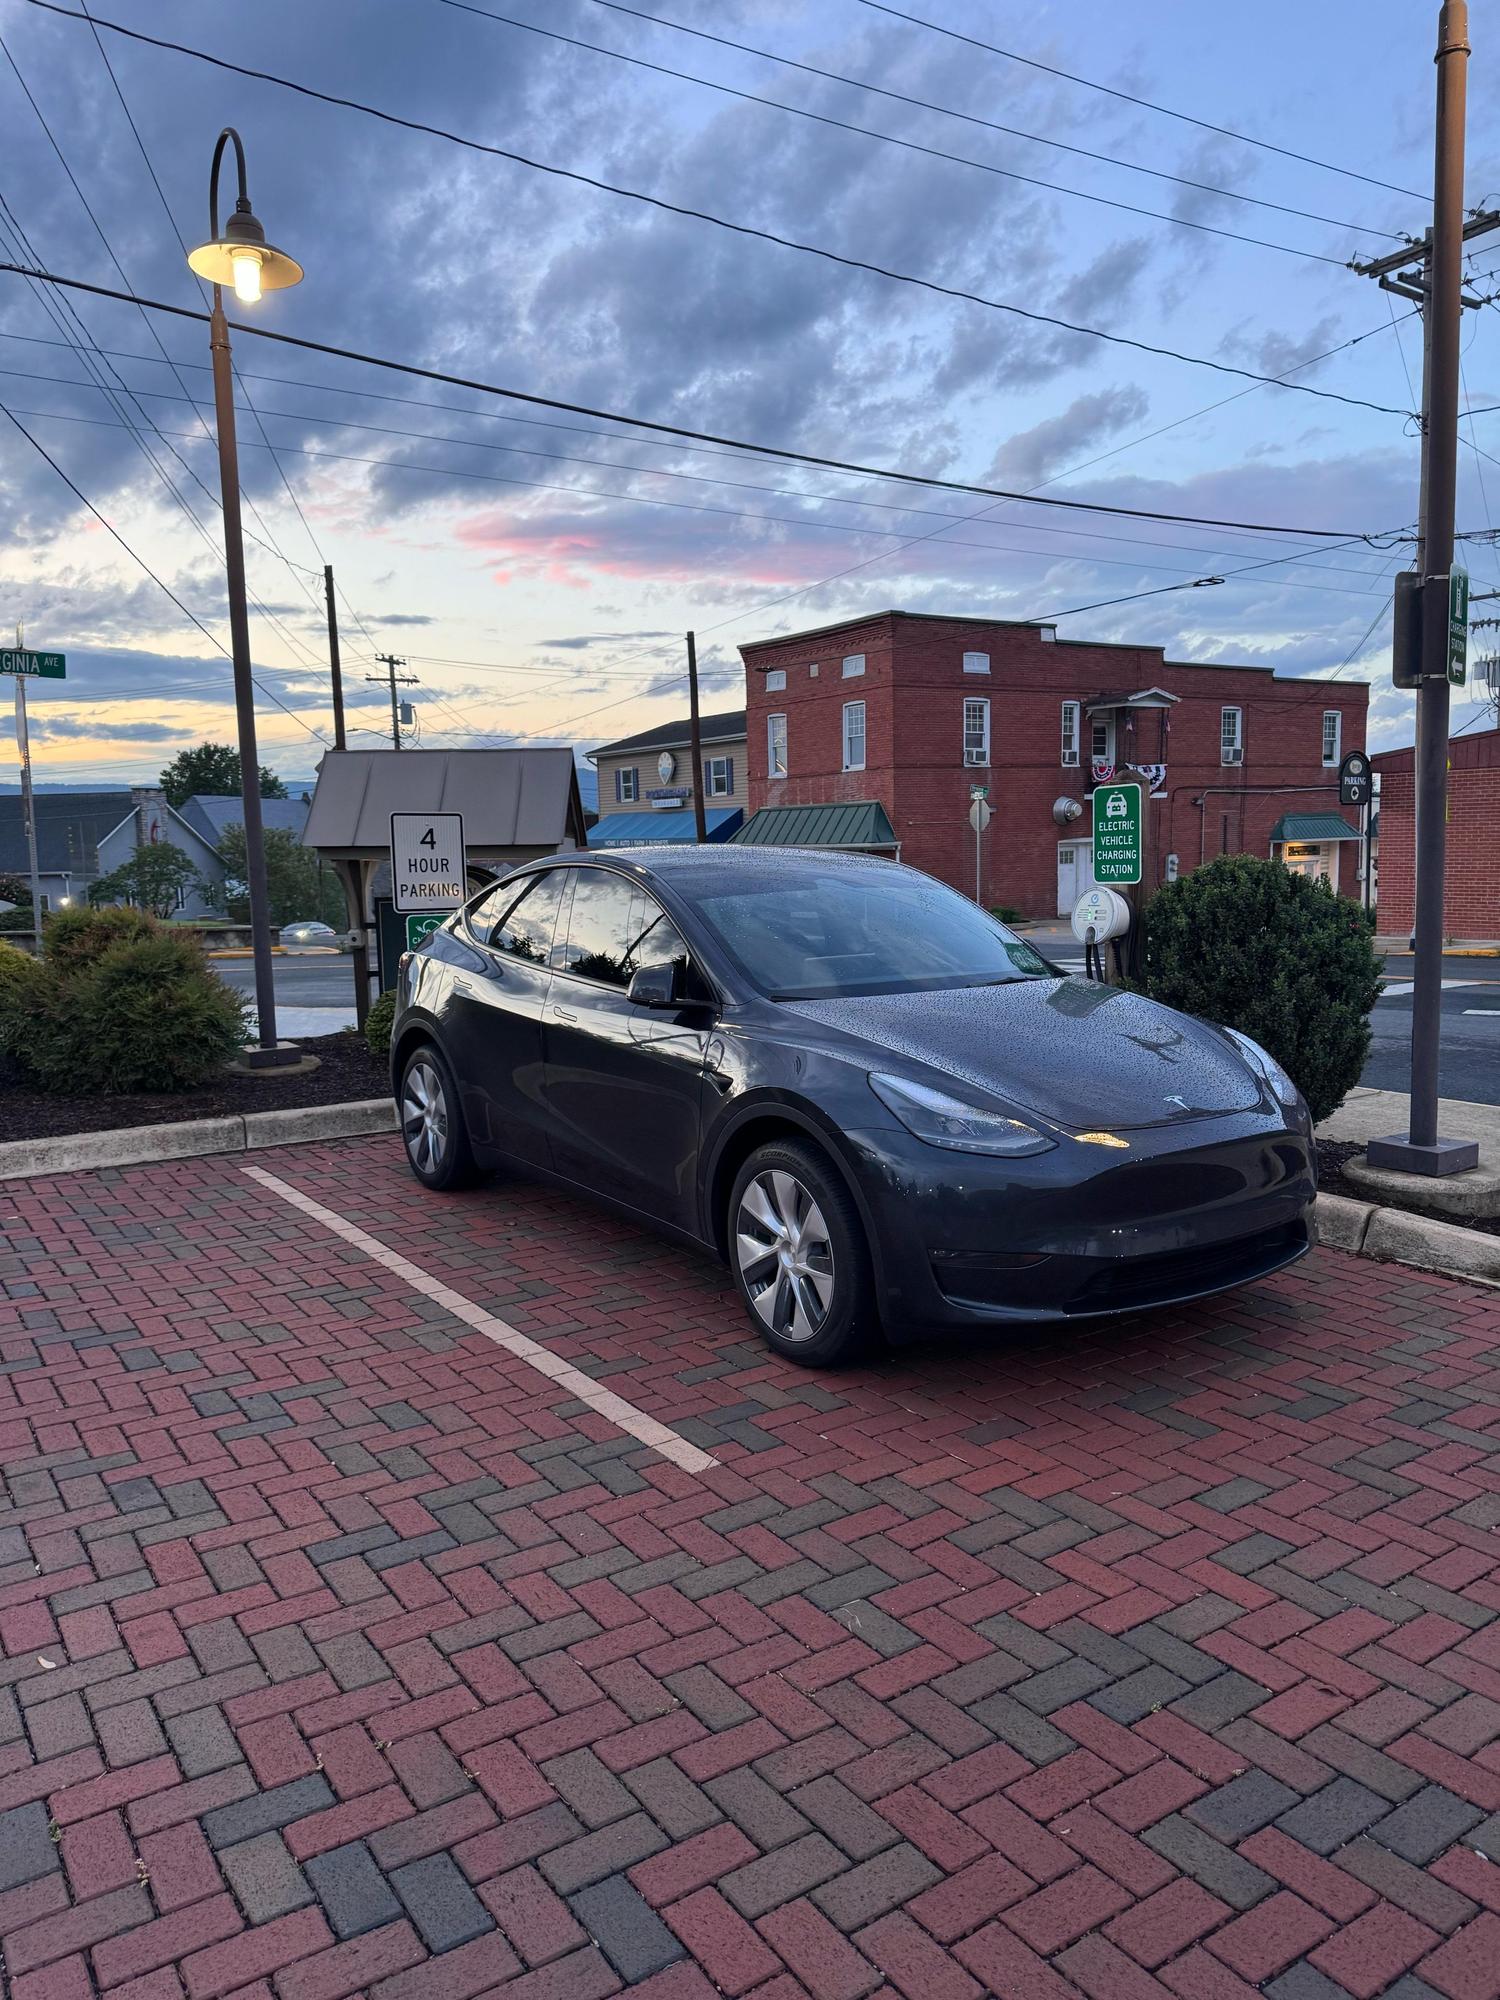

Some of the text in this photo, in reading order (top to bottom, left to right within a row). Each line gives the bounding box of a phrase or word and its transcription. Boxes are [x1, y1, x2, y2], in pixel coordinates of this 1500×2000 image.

[0, 653, 60, 673] GINIA AVE
[1344, 776, 1367, 785] PARKING
[1099, 820, 1135, 831] ELECTRIC
[420, 828, 436, 850] 4
[1101, 835, 1133, 845] VEHICLE
[1097, 850, 1137, 860] CHARGING
[408, 858, 450, 873] HOUR
[1101, 864, 1133, 874] STATION
[401, 883, 460, 898] PARKING
